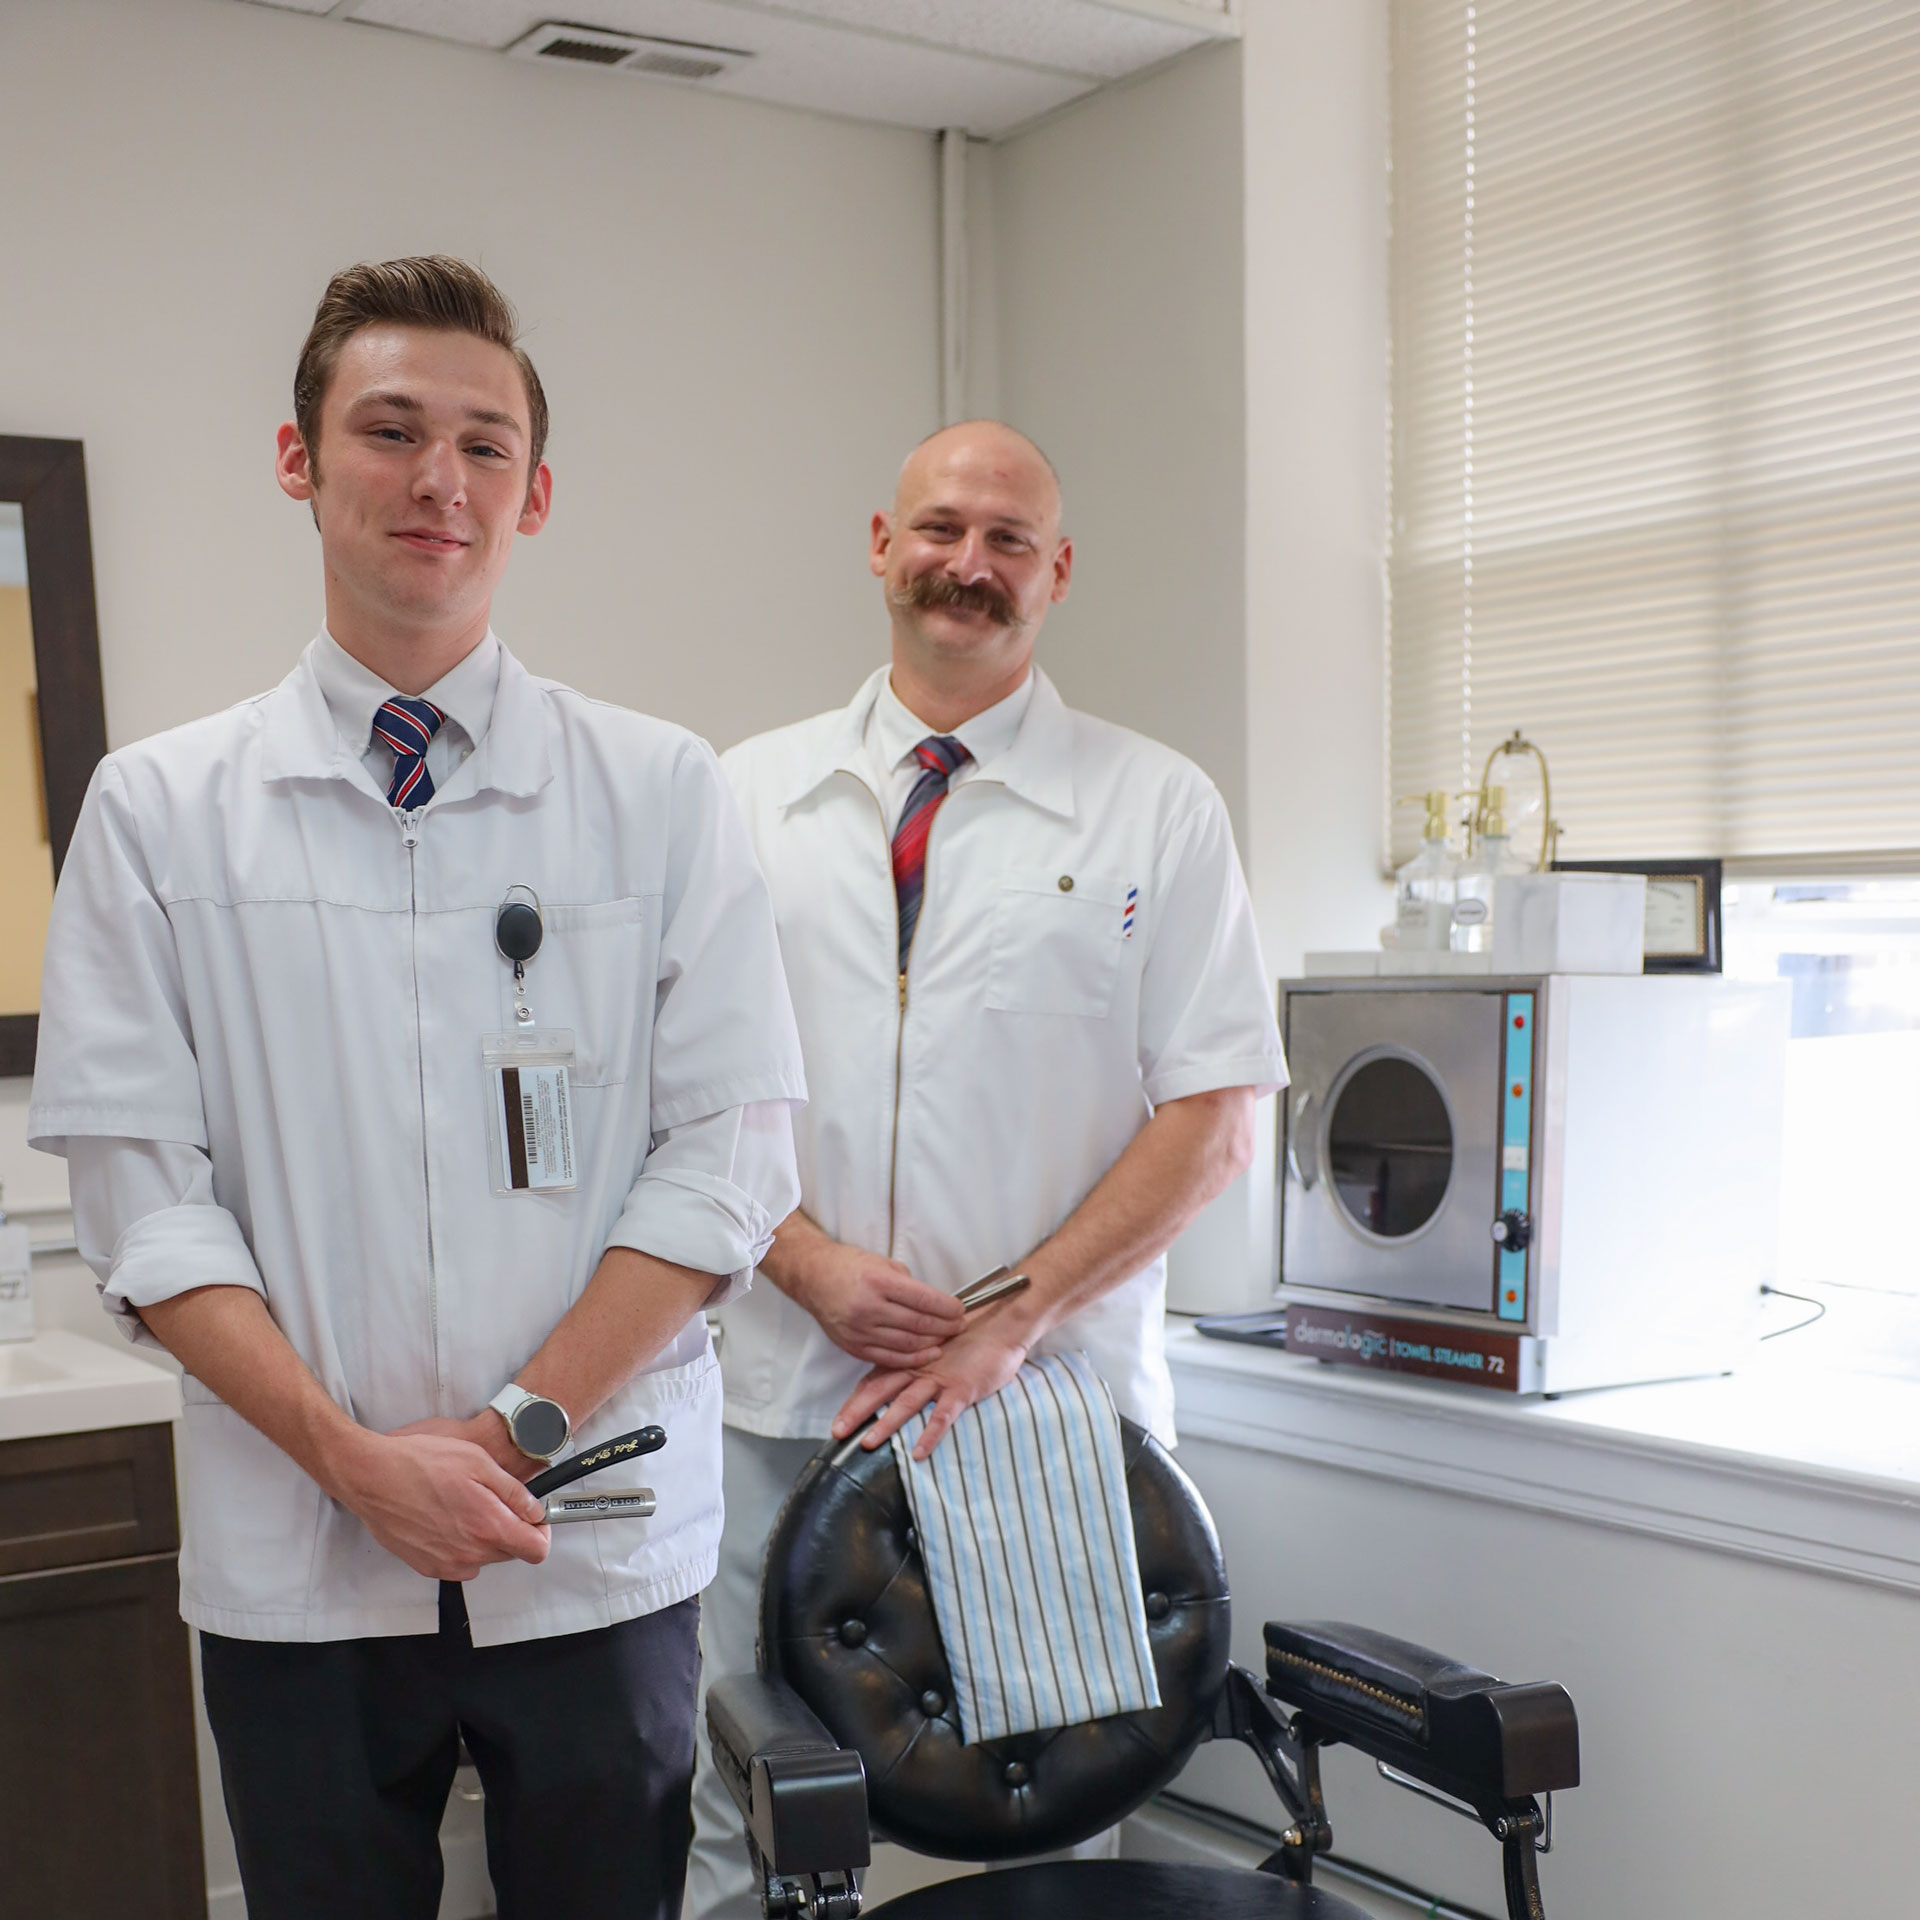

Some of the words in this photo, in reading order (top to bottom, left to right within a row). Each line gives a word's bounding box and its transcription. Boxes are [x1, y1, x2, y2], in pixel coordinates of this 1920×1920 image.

[1294, 1318, 1387, 1360] dermalogic
[1396, 1341, 1432, 1363] TOWEL
[1433, 1347, 1483, 1370] STEAMER
[1488, 1355, 1505, 1374] 72
[612, 1498, 639, 1506] GOLD
